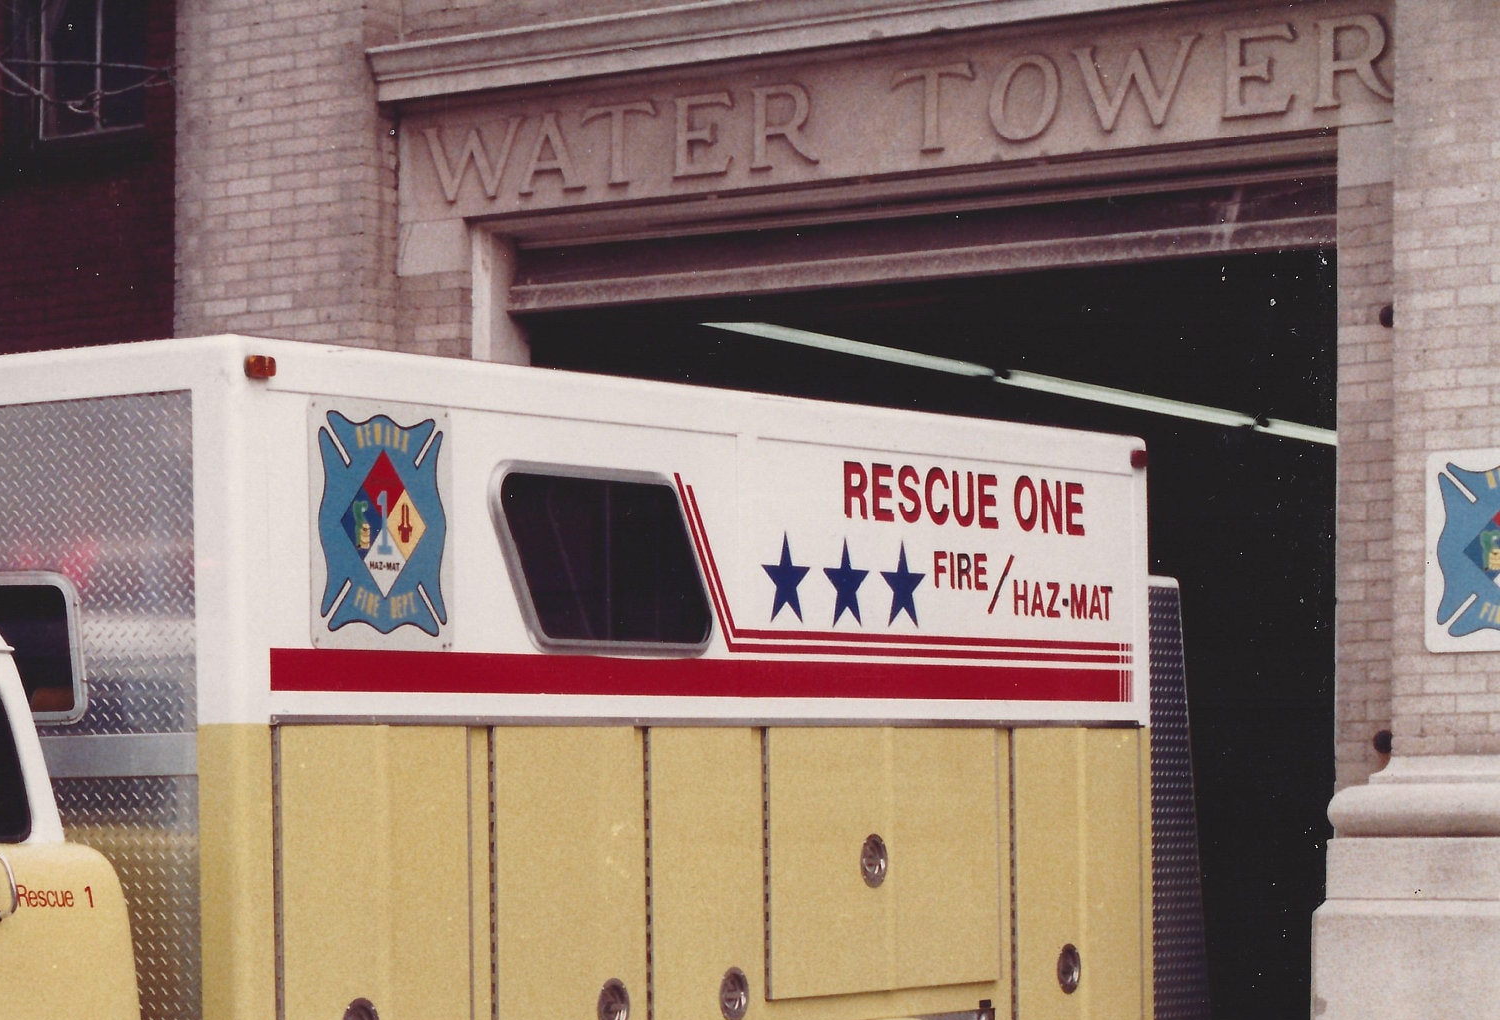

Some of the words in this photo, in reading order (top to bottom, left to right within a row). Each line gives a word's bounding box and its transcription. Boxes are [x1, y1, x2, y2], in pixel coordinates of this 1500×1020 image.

[422, 83, 819, 204] WATER
[891, 13, 1393, 154] TOWER
[843, 460, 999, 529] RESCUE
[1013, 475, 1086, 537] ONE
[369, 560, 401, 573] HAZ-MAT
[16, 884, 74, 908] Rescue
[84, 885, 94, 908] 1
